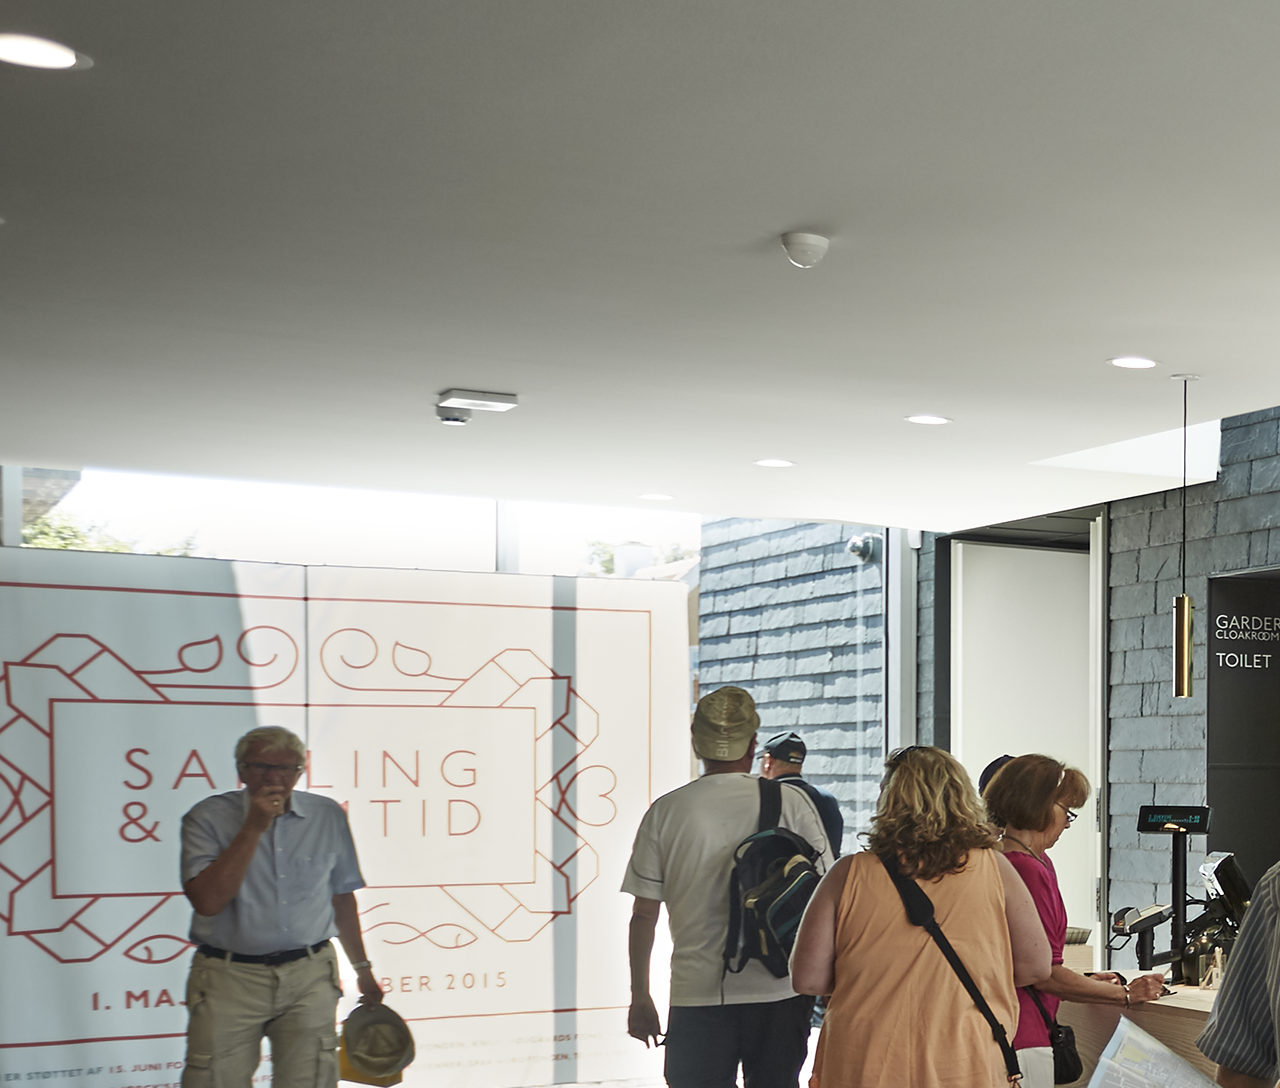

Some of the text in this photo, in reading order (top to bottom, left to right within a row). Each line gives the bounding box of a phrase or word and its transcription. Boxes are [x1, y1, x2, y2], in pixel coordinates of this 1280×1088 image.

[1215, 629, 1280, 641] CLOAKROOM
[1215, 653, 1272, 668] TOILET
[123, 748, 477, 790] SALING
[119, 801, 162, 843] &
[446, 971, 507, 991] 2015
[27, 1068, 83, 1081] STØTTET
[86, 1066, 104, 1076] AF
[131, 1063, 162, 1074] JUNI
